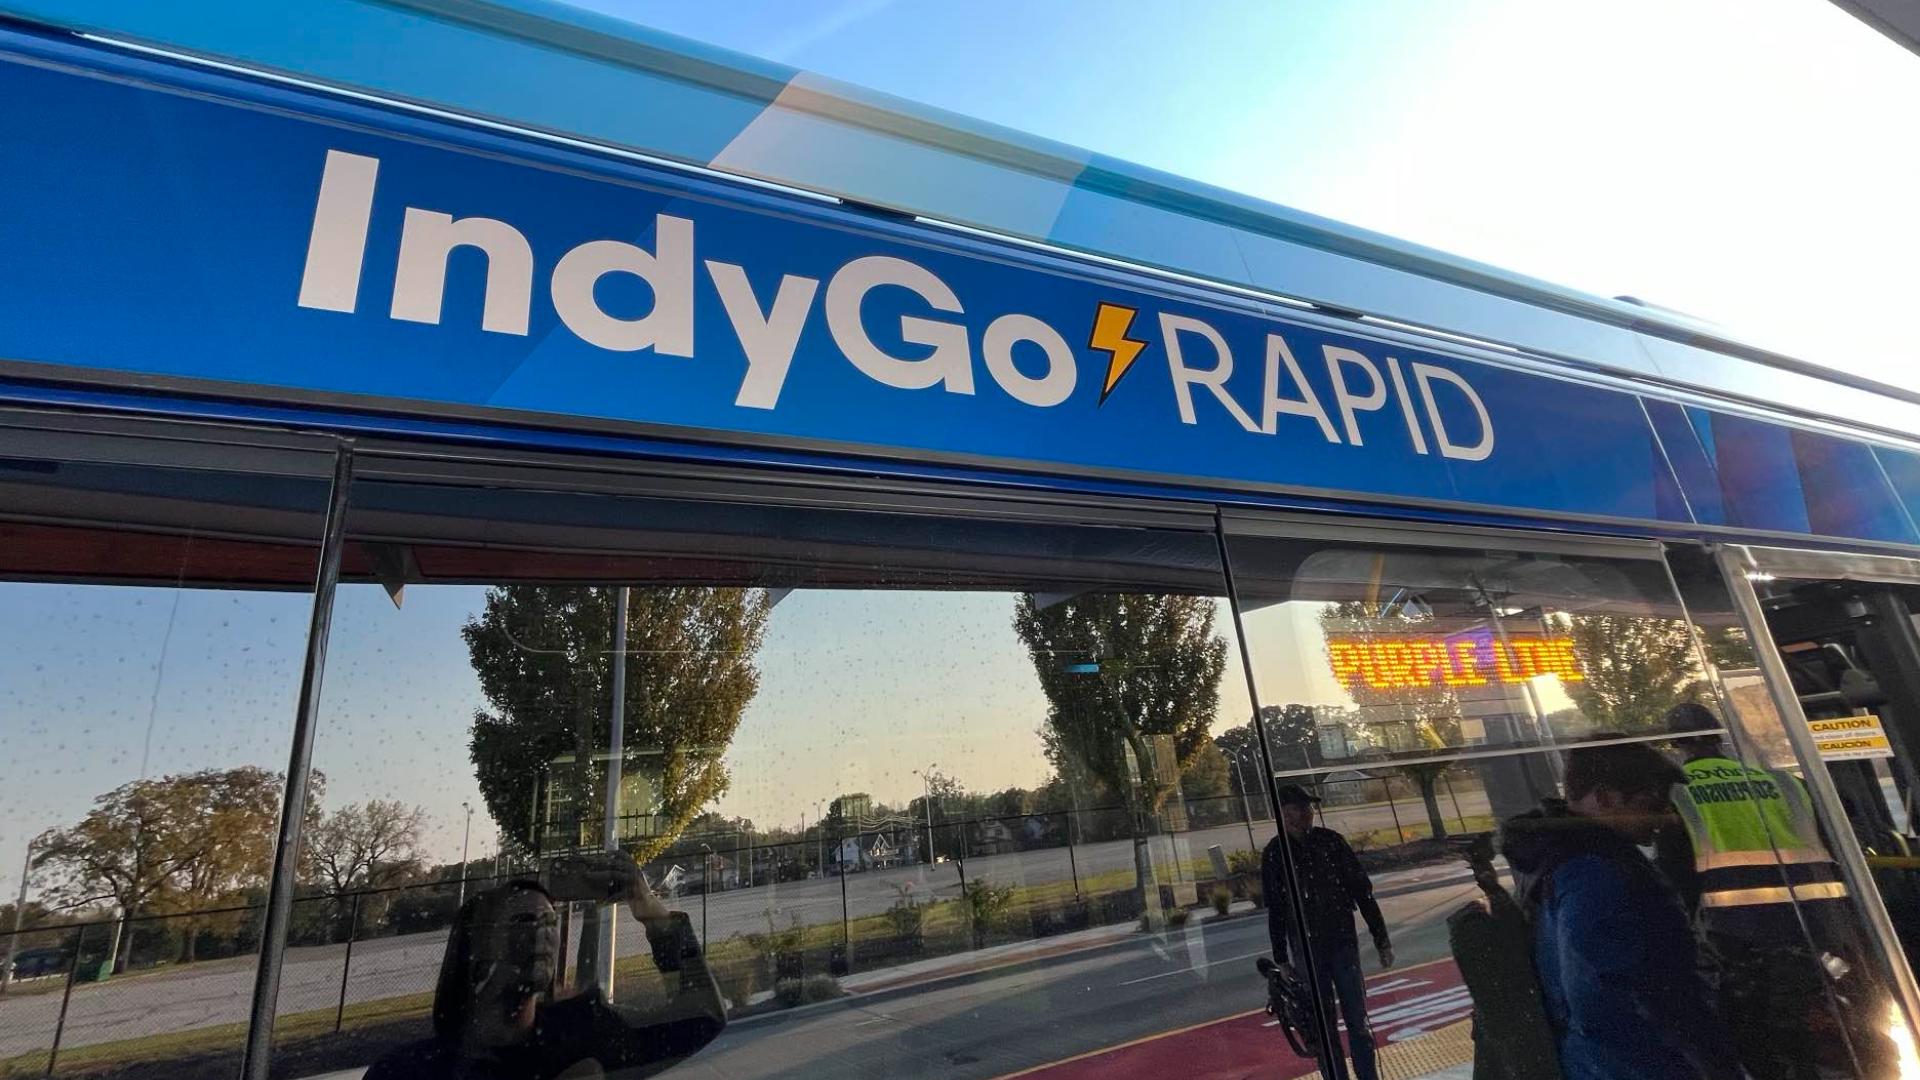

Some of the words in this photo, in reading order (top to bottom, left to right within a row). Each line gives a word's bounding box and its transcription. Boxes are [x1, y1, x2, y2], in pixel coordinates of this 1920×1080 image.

[298, 149, 1077, 409] IndyGo
[1158, 311, 1495, 461] RAPID
[1328, 638, 1487, 688] PURPLE
[1492, 636, 1585, 682] LINE
[1811, 720, 1871, 732] CAUTION
